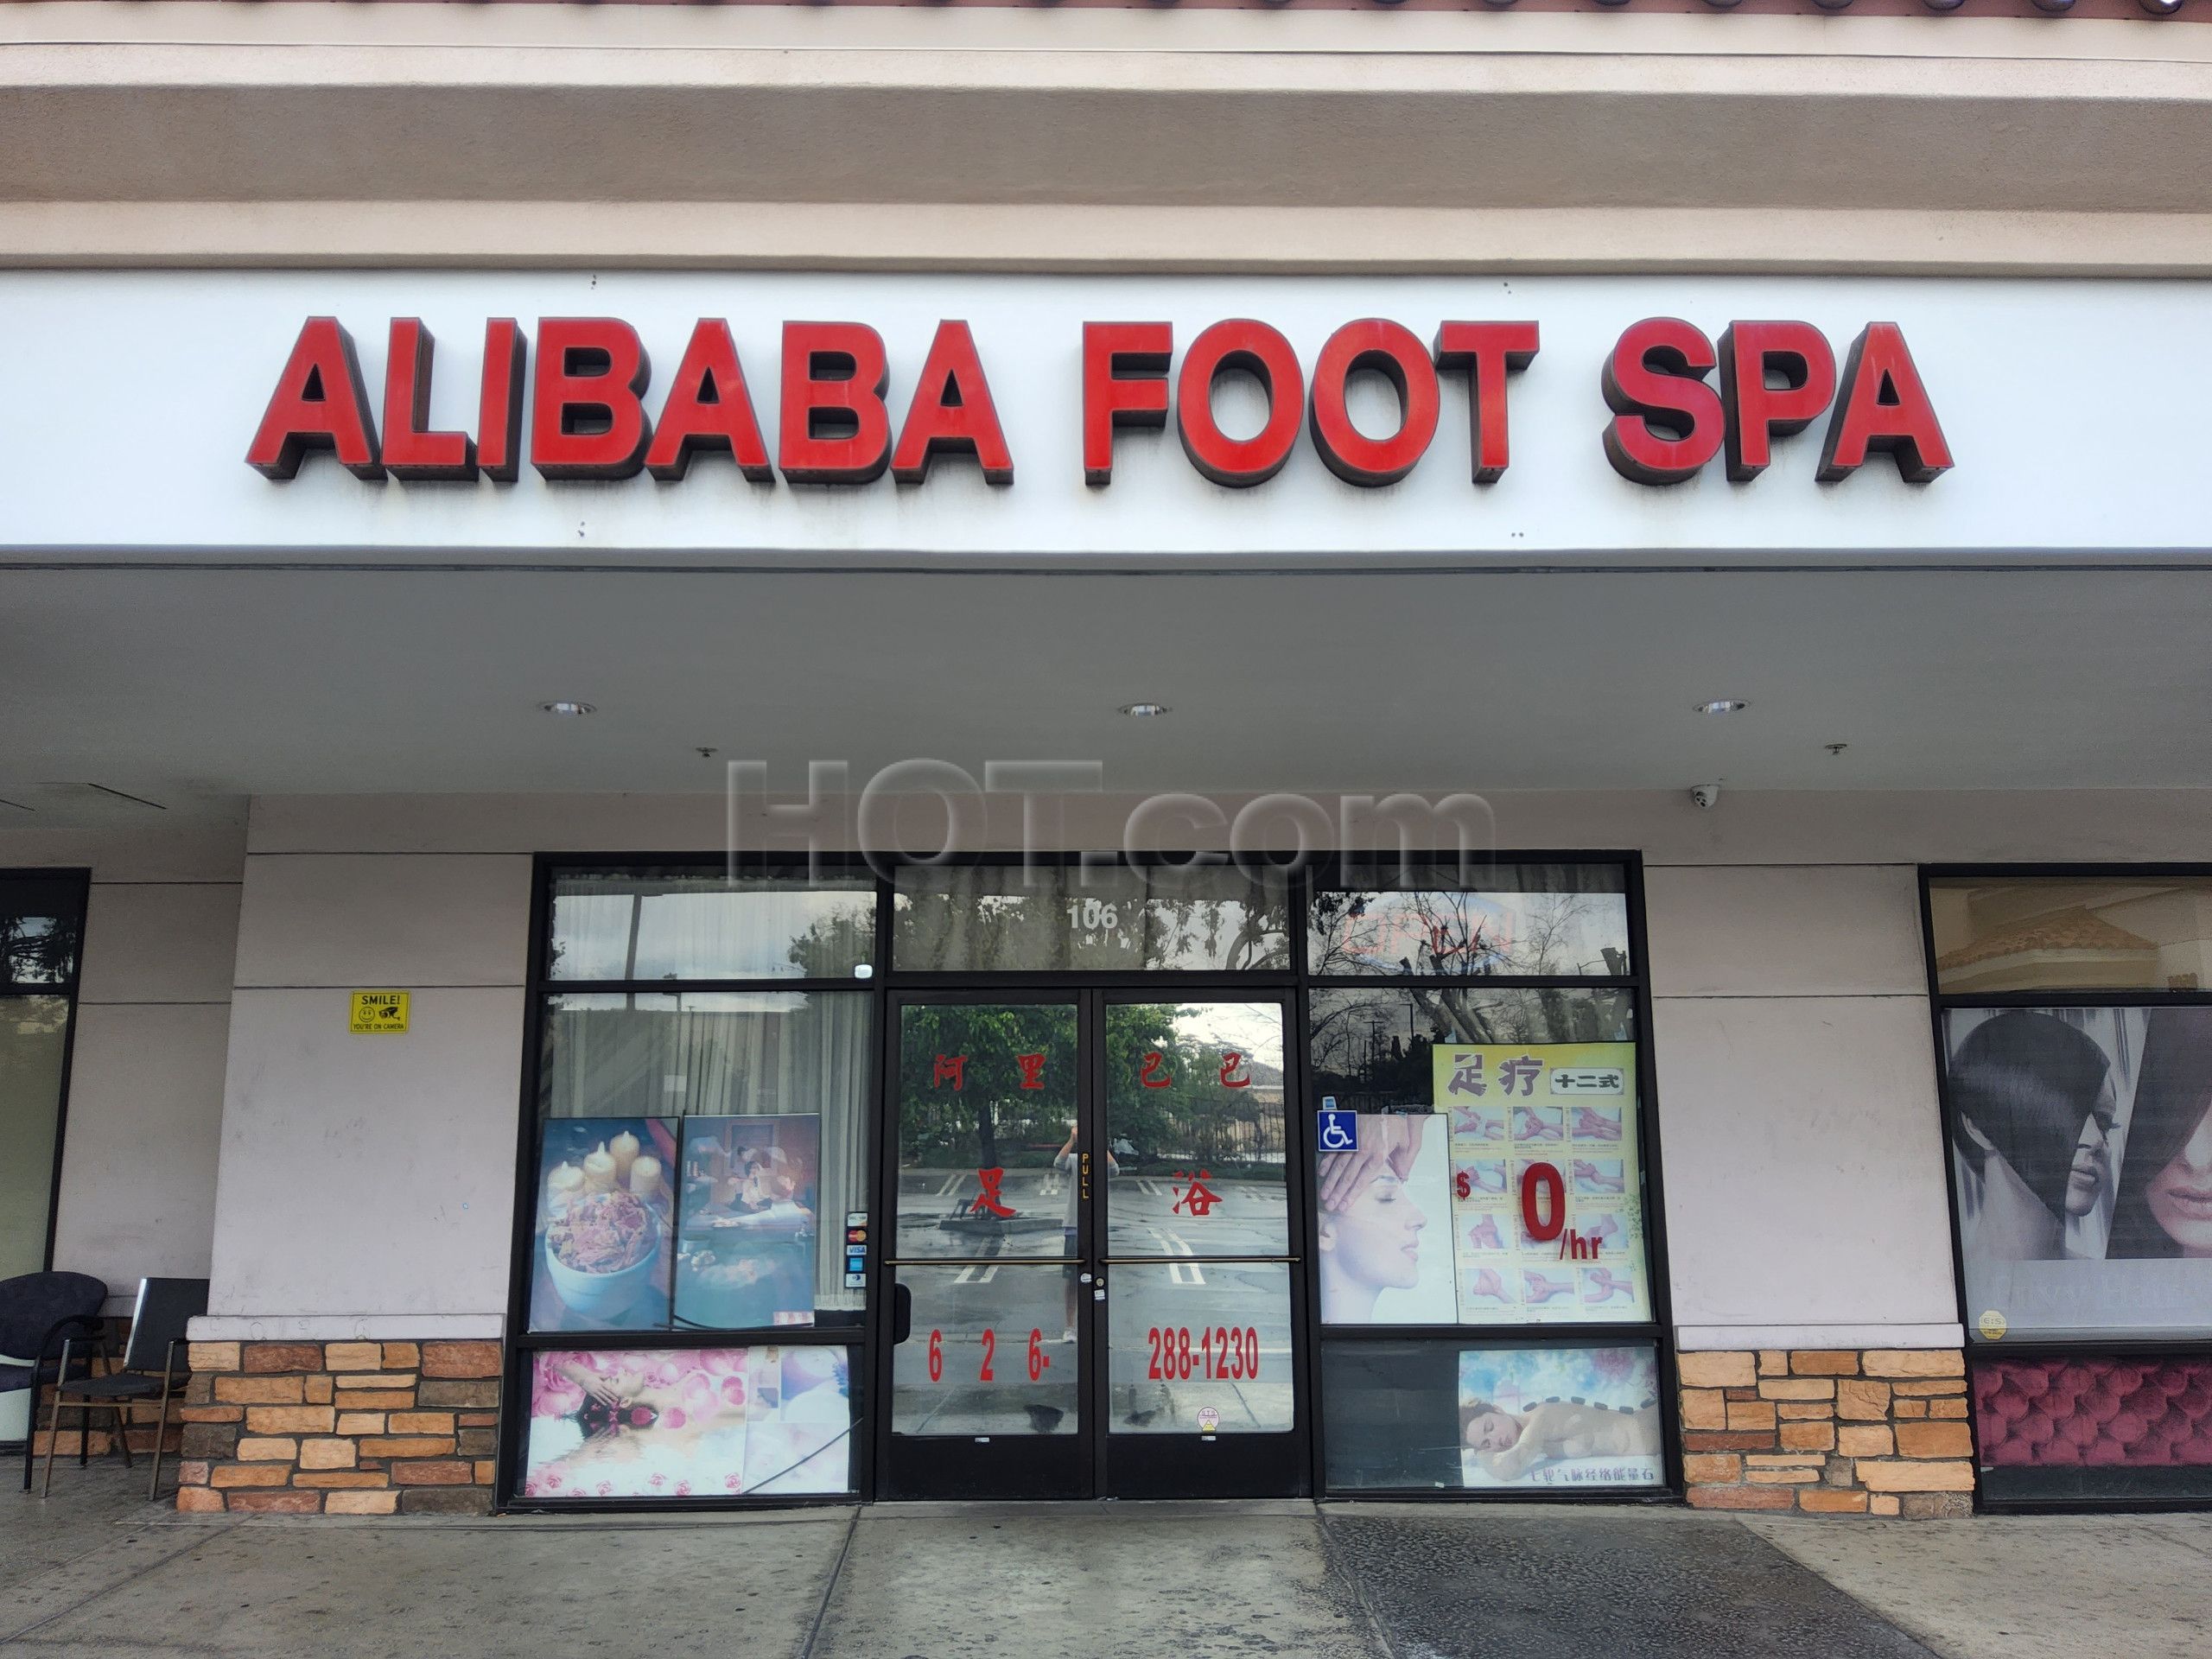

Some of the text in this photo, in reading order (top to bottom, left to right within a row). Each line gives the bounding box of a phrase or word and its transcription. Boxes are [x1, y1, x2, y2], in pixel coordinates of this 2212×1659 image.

[245, 315, 1955, 488] ALIBABA FOOT SPA
[1066, 903, 1118, 929] 106
[1342, 912, 1512, 955] OPEN
[361, 995, 401, 1005] SMILE!
[1447, 1053, 1544, 1097] 足疗
[1554, 1074, 1620, 1090] 十二式
[1147, 1326, 1259, 1380] 288-1230
